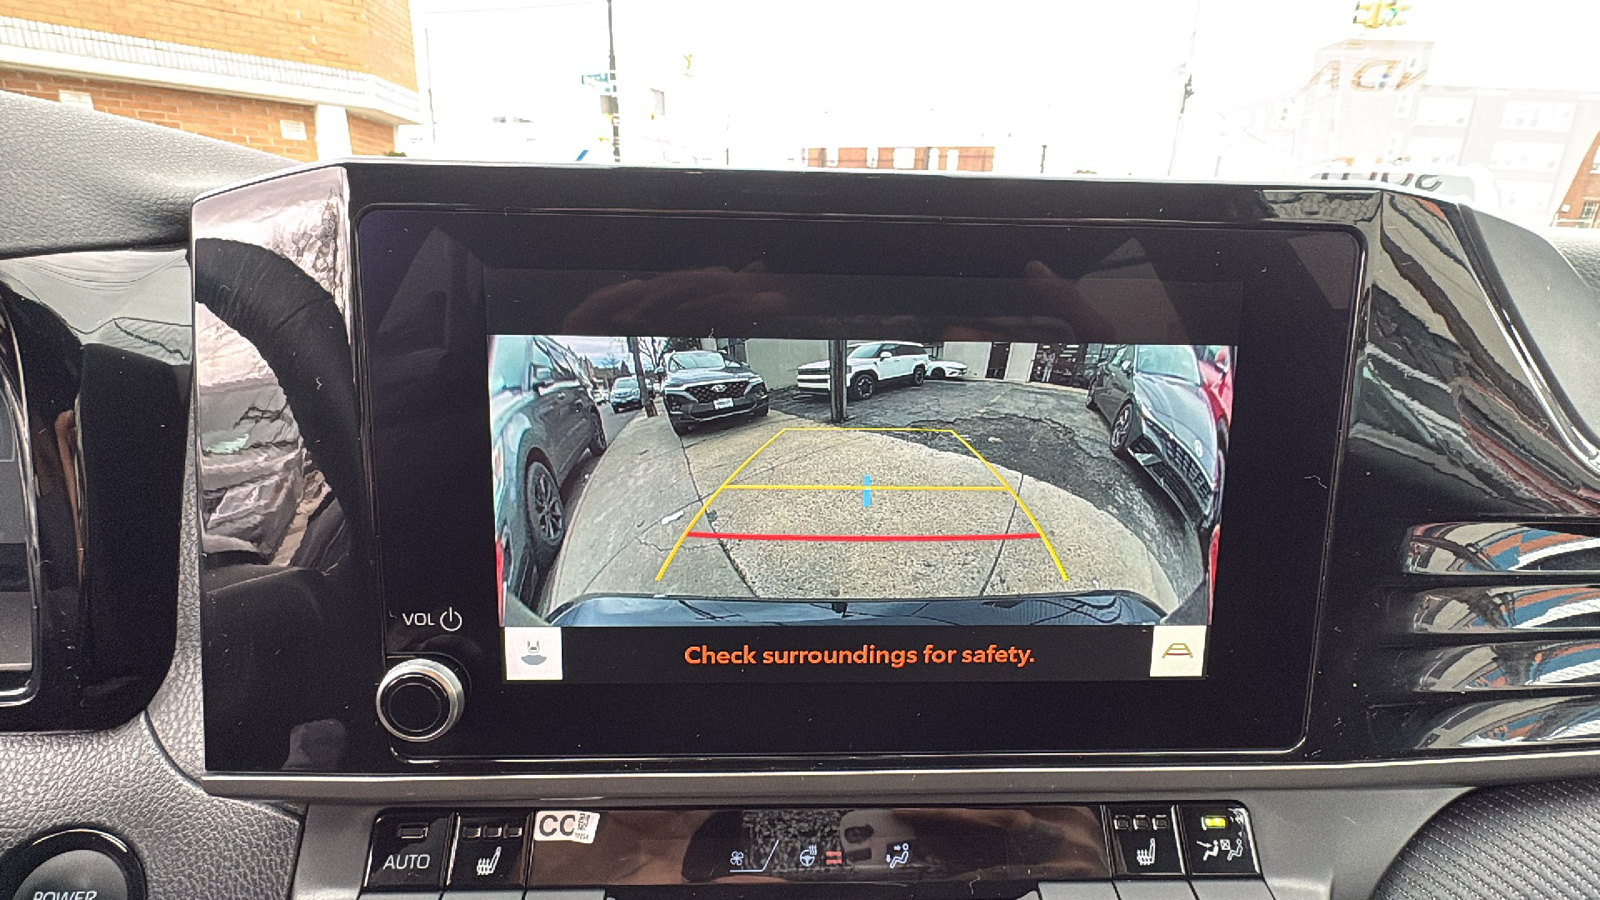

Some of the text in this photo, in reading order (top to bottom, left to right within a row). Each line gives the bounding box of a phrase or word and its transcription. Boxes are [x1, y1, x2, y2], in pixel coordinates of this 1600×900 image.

[402, 612, 435, 626] VOL
[684, 645, 1035, 668] Check surroundings for safety.
[538, 814, 576, 837] CC
[383, 854, 430, 870] AUTO
